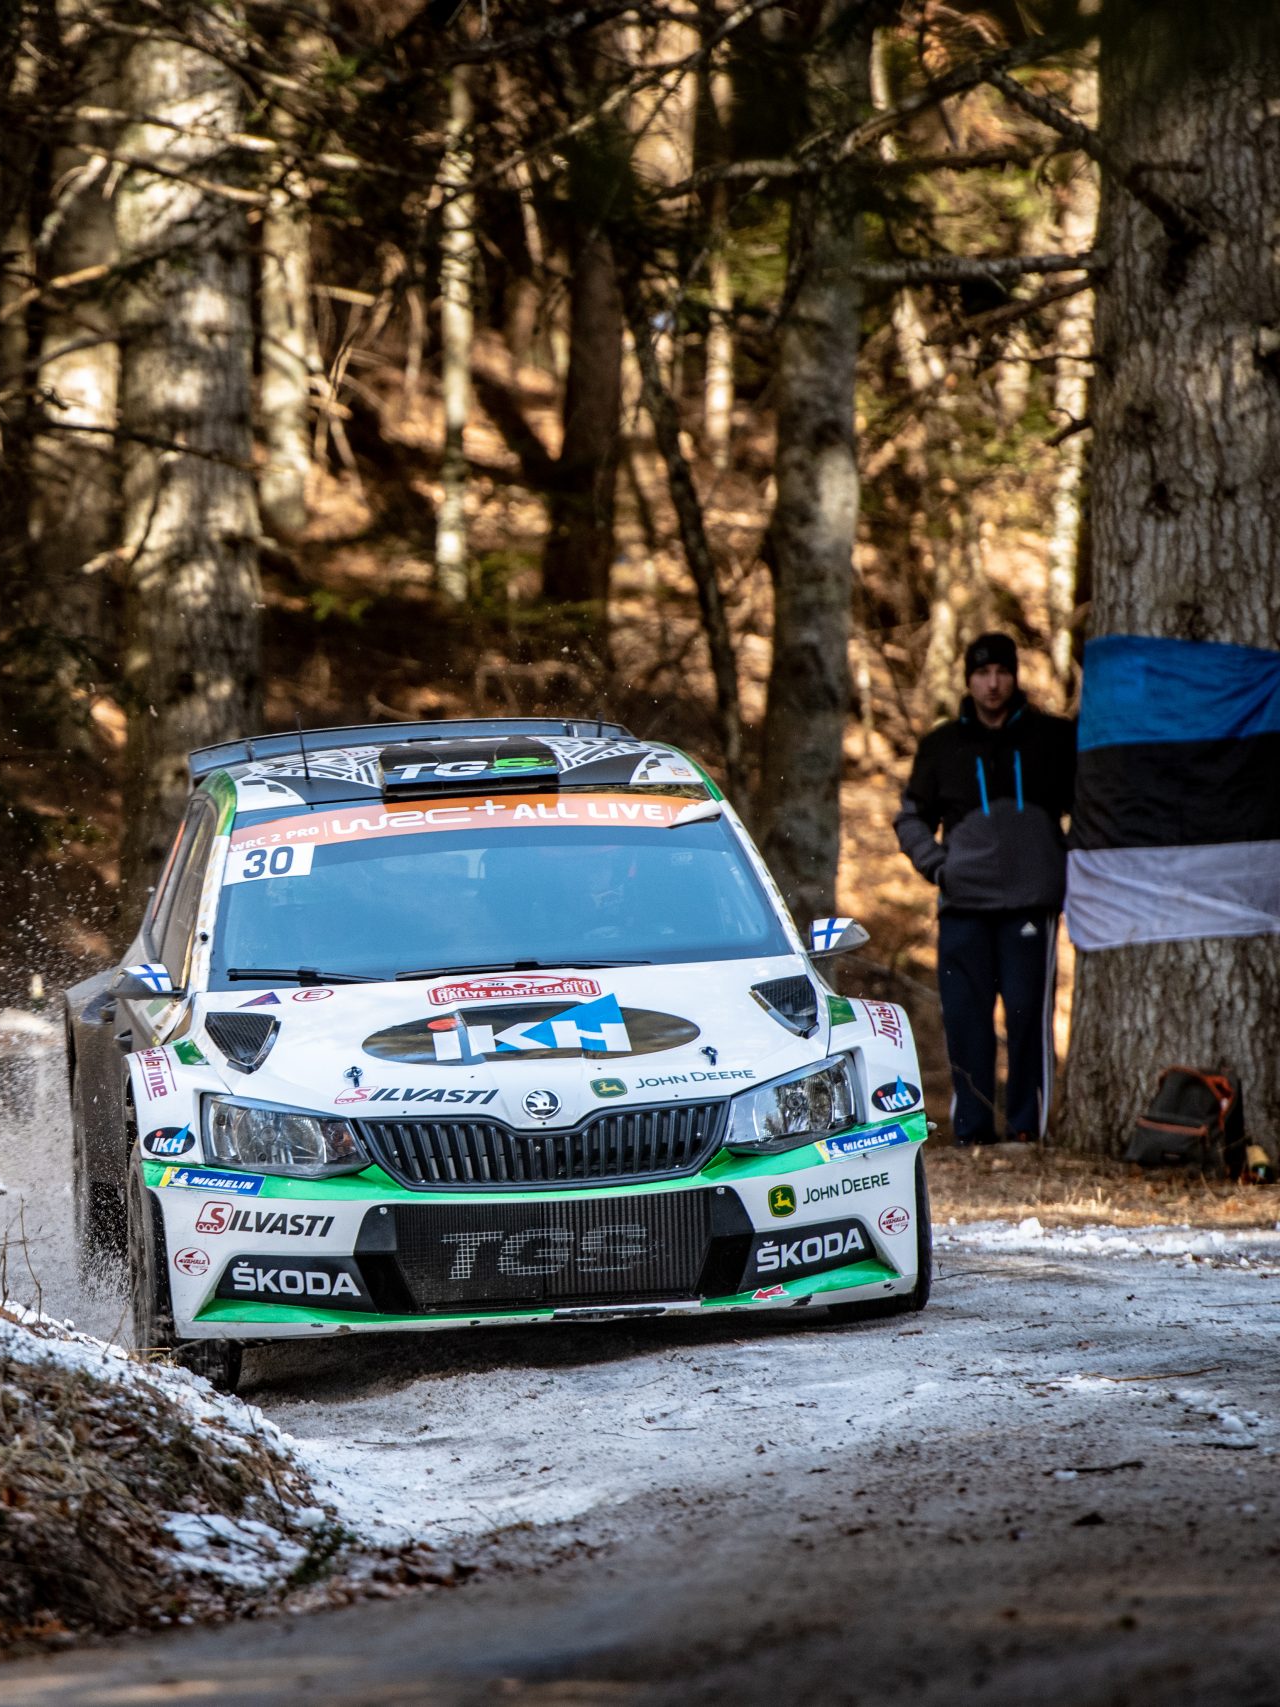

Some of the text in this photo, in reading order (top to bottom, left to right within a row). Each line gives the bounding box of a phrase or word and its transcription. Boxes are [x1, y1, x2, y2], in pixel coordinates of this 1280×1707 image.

[393, 757, 543, 779] TGS
[512, 803, 578, 819] ALL
[587, 803, 665, 820] LIVE
[230, 826, 320, 852] WRC 2 PRO
[242, 846, 294, 879] 30
[302, 990, 325, 999] E
[437, 983, 592, 1003] RALLYE MONTE-CARLO
[635, 1069, 756, 1089] JOHN DEERE
[352, 1087, 499, 1105] SILVASTI
[843, 1131, 898, 1152] MICHELIN
[190, 1176, 255, 1190] MICHELIN
[803, 1172, 890, 1205] JOHN DEERE
[210, 1207, 335, 1237] SILVASTI
[441, 1224, 650, 1280] TGS
[756, 1228, 865, 1272] ŠKODA
[232, 1261, 361, 1297] ŠKODA
